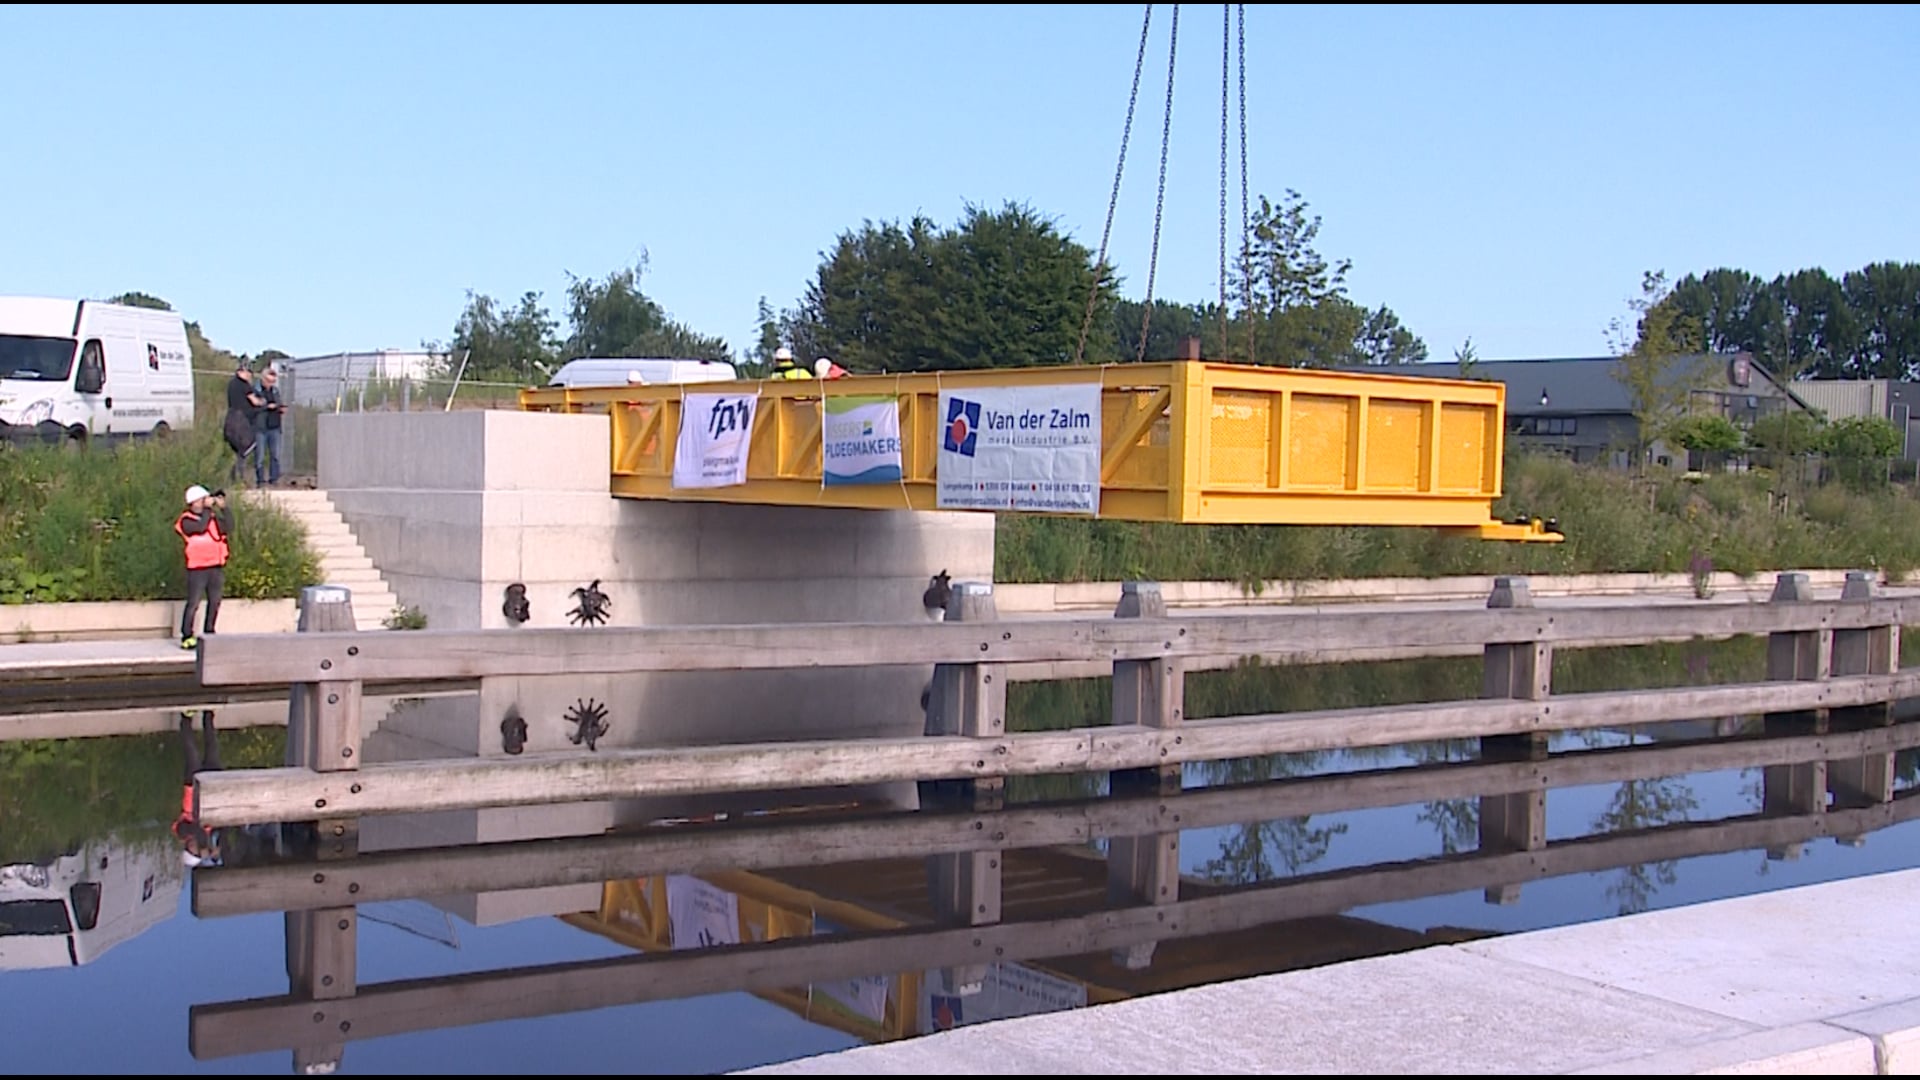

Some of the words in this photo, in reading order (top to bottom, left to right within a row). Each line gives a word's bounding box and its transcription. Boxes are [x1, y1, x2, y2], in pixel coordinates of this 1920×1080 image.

[986, 411, 1014, 430] Van
[1019, 408, 1046, 430] der
[1049, 407, 1090, 429] Zalm
[988, 434, 1067, 446] metaalindustrie
